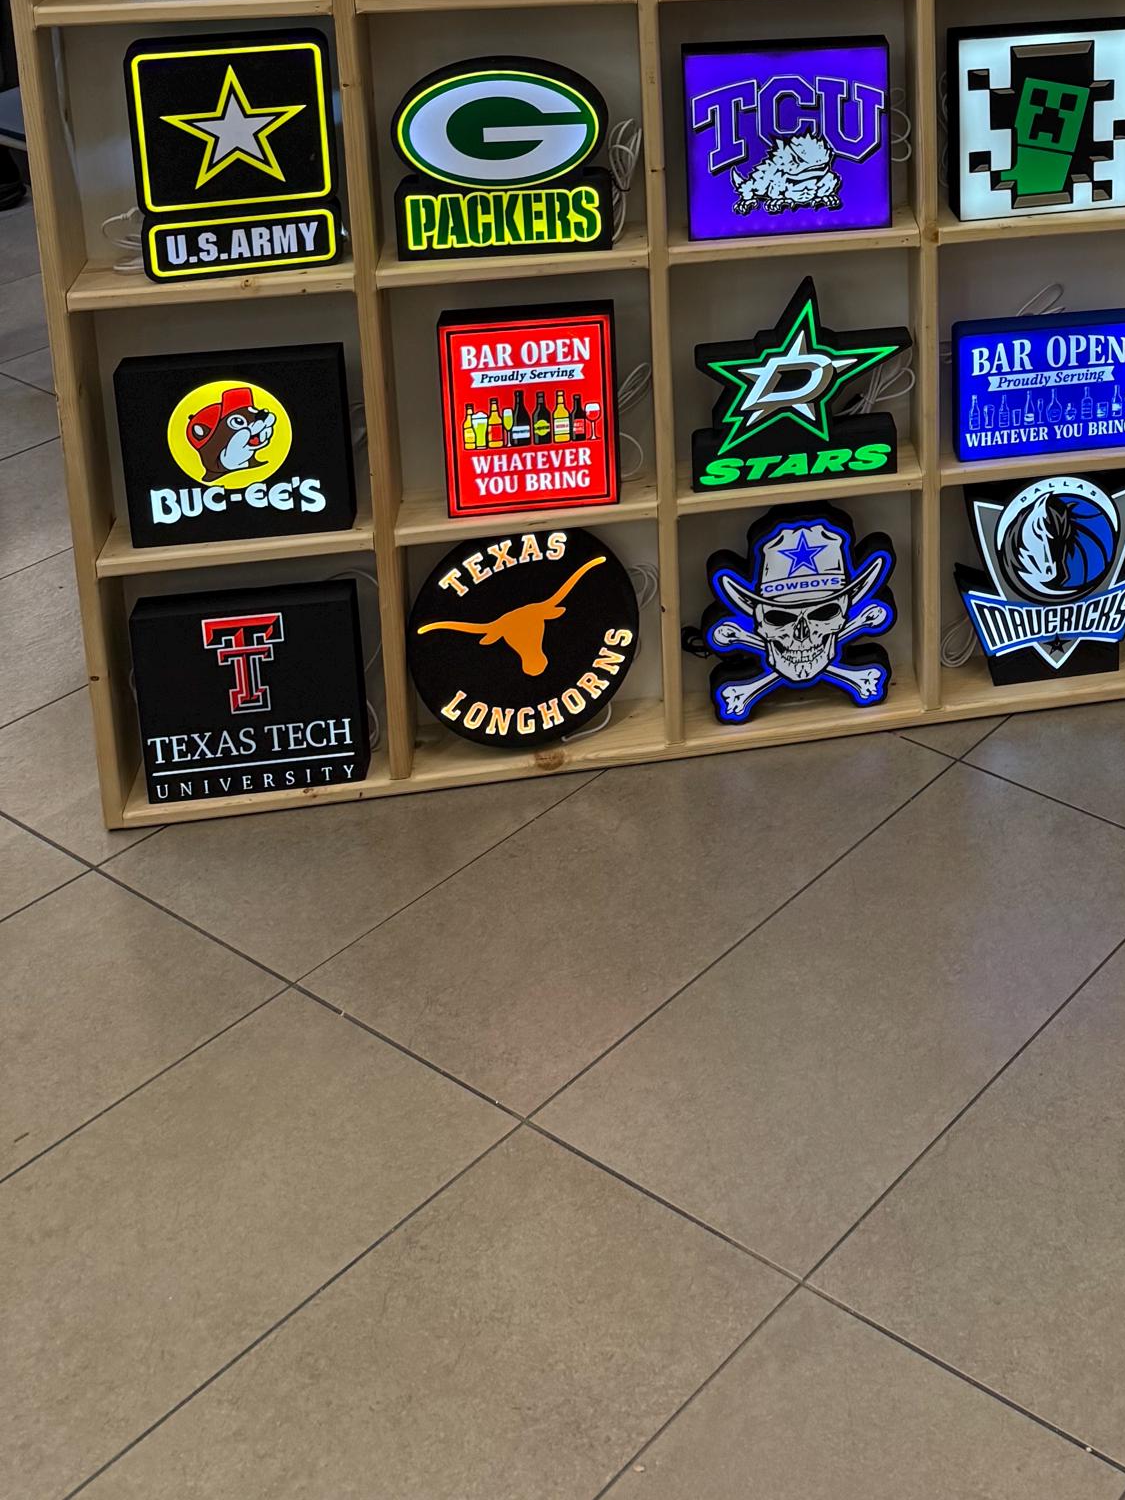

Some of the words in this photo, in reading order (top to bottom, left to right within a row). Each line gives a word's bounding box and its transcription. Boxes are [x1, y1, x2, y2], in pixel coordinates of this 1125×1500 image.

[409, 80, 588, 181] G
[692, 74, 885, 175] TCU
[405, 186, 601, 251] PACKERS
[460, 343, 514, 370] BAR
[520, 336, 591, 366] OPEN
[971, 338, 1033, 376] BAR
[480, 370, 527, 384] Proudly
[529, 367, 576, 381] Serving
[996, 373, 1051, 388] Proudly
[1054, 368, 1105, 384] Serving
[965, 426, 1049, 448] WHATEVER
[1054, 422, 1083, 440] YOU
[472, 447, 592, 475] WHATEVER
[700, 443, 892, 486] STARS
[475, 474, 518, 496] YOU
[525, 470, 591, 492] BRING
[1020, 481, 1098, 503] DALLAS
[438, 532, 568, 598] TEXAS
[763, 577, 840, 594] COWBOYS
[440, 627, 633, 737] LONGHORNS
[147, 726, 257, 765] TEXAS
[264, 718, 354, 752] TECH
[155, 762, 356, 800] UNIVERSITY
